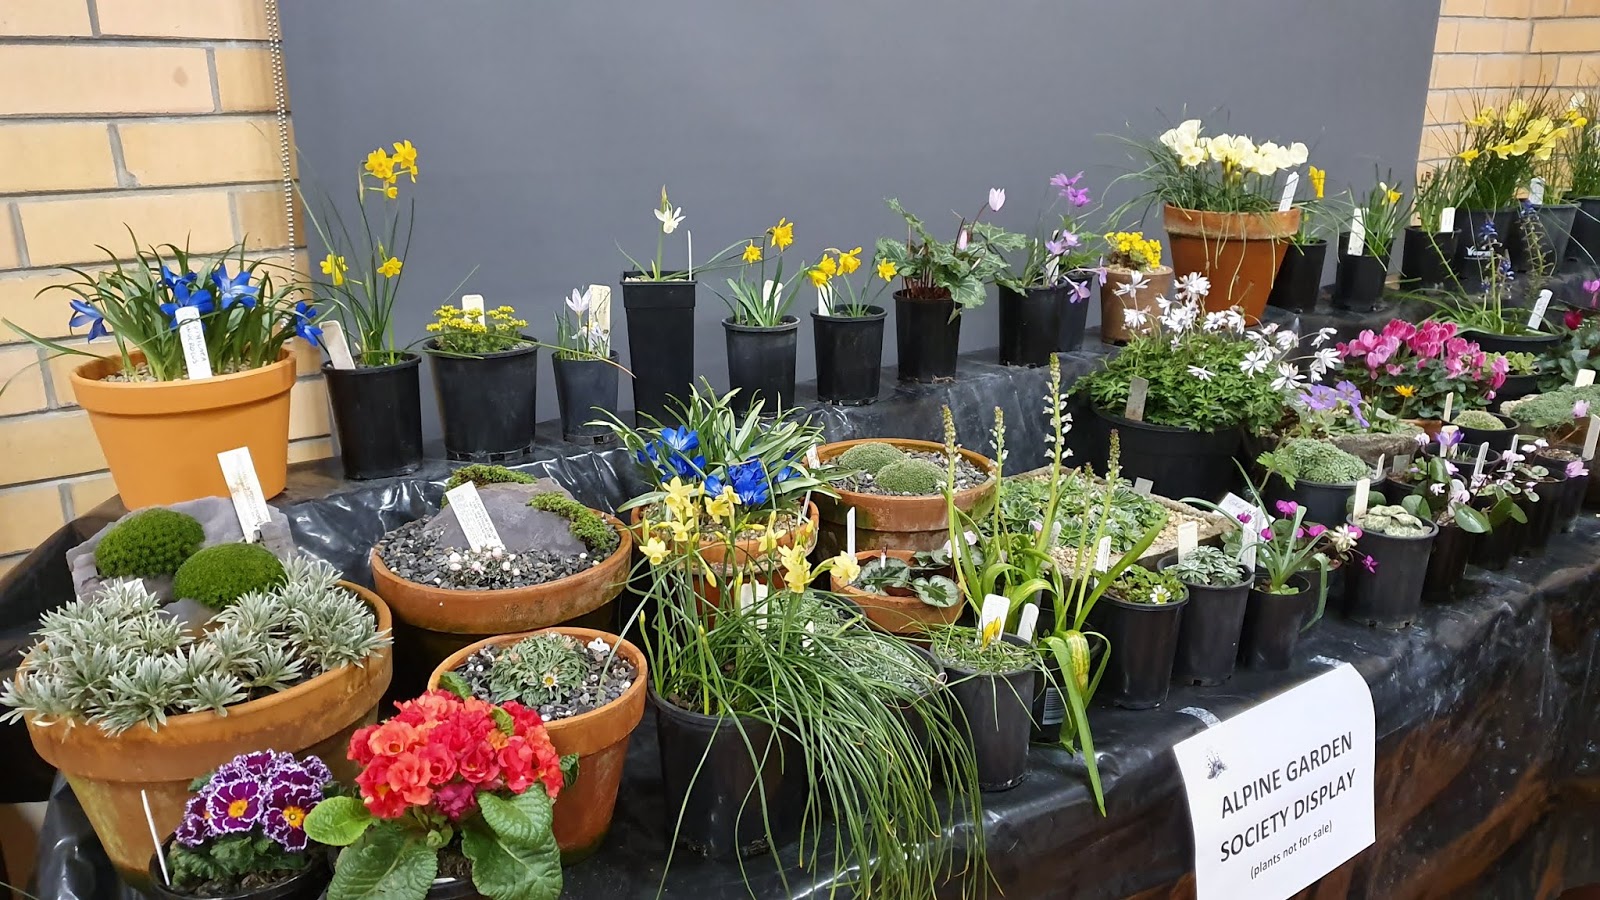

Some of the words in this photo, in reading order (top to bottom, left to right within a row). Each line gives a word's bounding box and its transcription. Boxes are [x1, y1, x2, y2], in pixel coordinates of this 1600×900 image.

[1220, 806, 1289, 863] SOCIETY
[1294, 768, 1355, 820] DISPLAY
[1221, 768, 1282, 819] ALPINE
[1286, 731, 1352, 782] GARDEN
[1250, 853, 1281, 880] (plants
[1283, 842, 1297, 858] not
[1299, 834, 1312, 848] for
[1313, 820, 1333, 841] sale)
